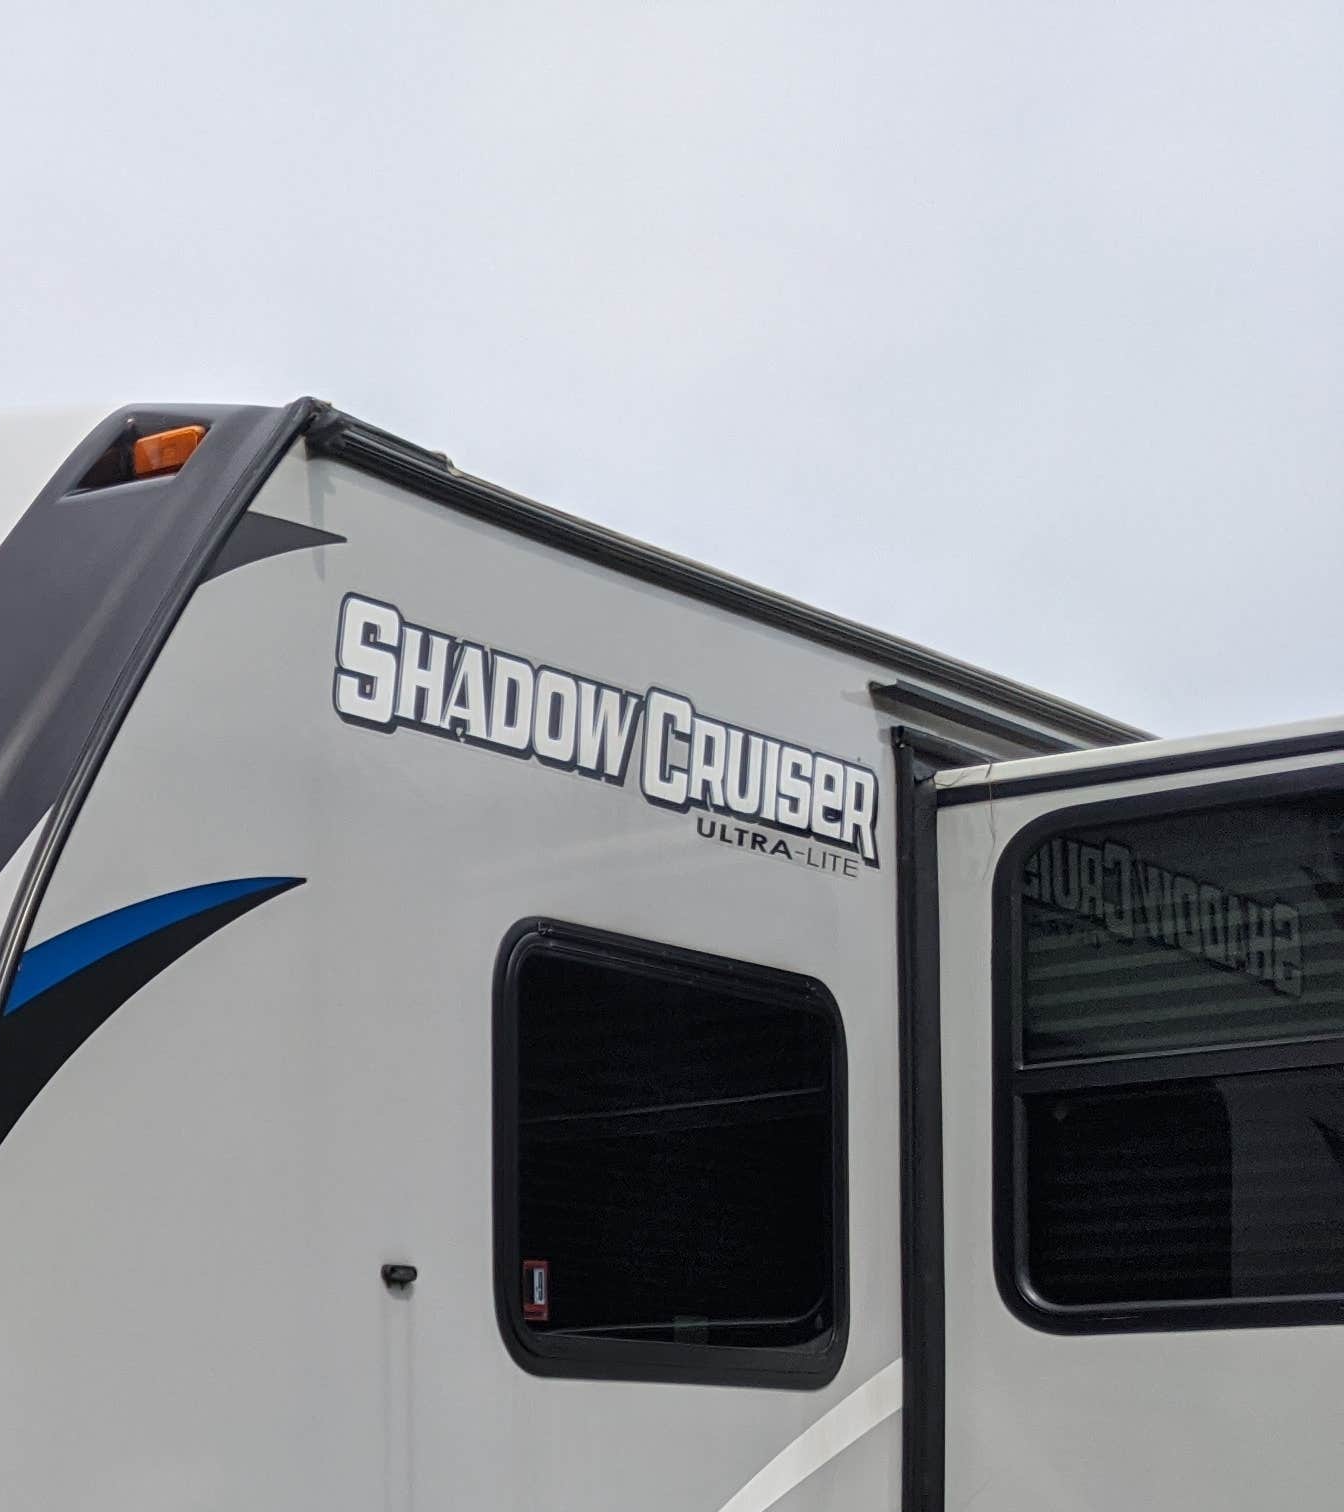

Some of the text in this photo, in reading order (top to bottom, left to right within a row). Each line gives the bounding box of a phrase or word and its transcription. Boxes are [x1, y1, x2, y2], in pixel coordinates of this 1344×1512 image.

[333, 592, 881, 870] SHADOW CRUISER
[695, 817, 859, 879] ULTRA-LITE
